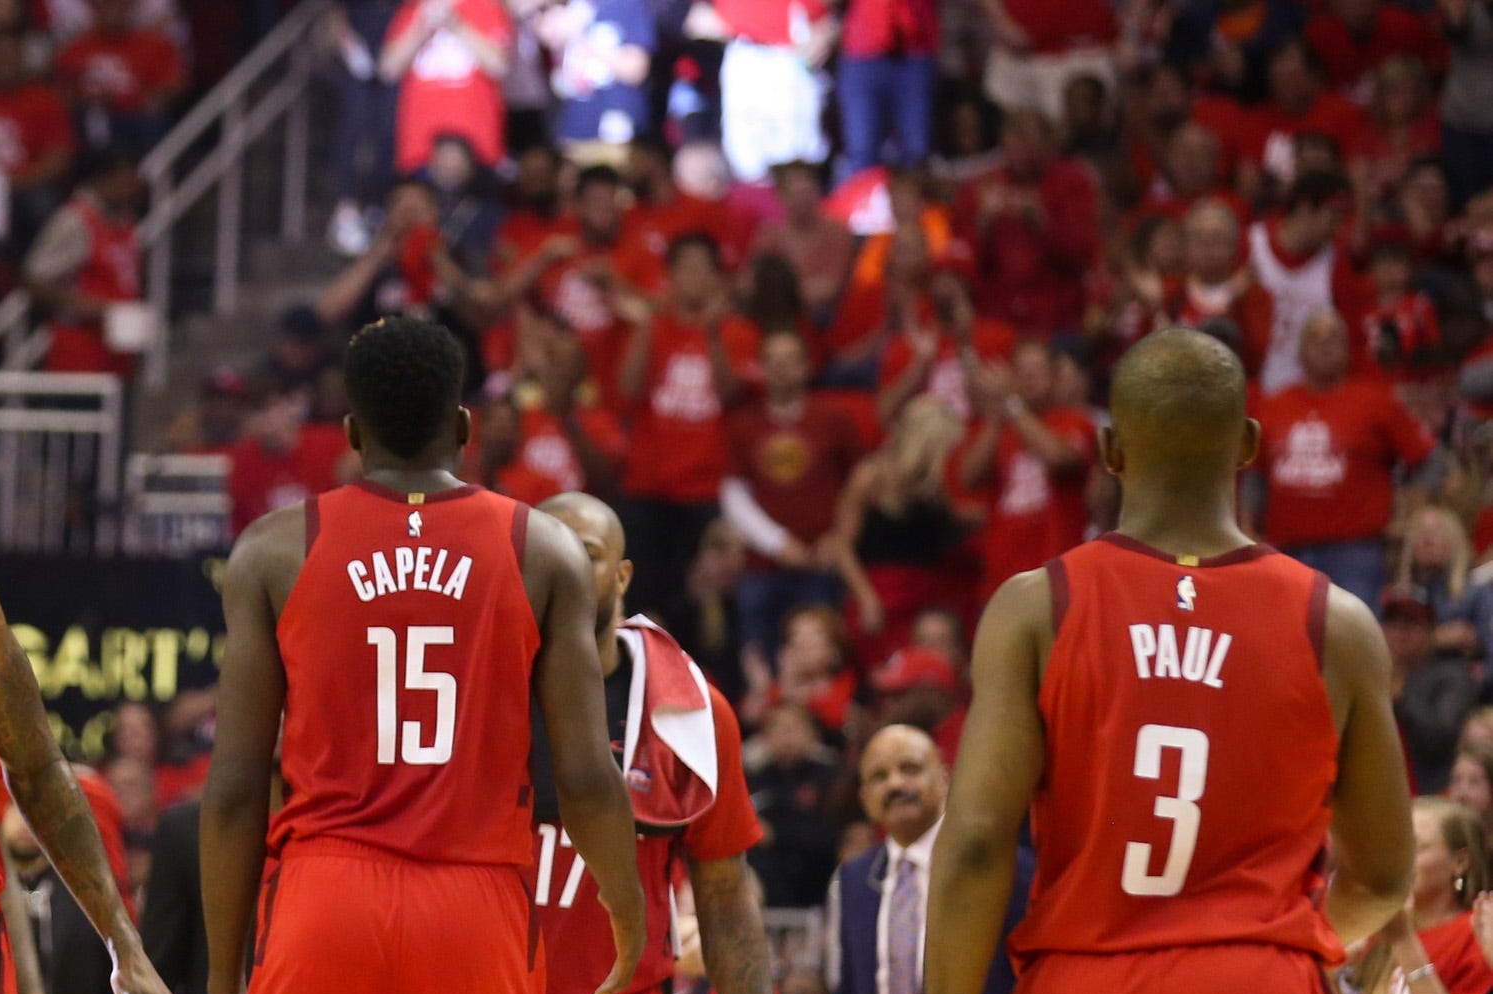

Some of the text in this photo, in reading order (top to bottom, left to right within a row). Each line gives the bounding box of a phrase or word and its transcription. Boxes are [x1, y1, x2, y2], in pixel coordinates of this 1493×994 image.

[347, 546, 473, 602] CAPELA
[367, 625, 457, 764] 15
[1129, 623, 1233, 689] PAUL
[1121, 723, 1210, 896] 3
[535, 822, 586, 908] 17
